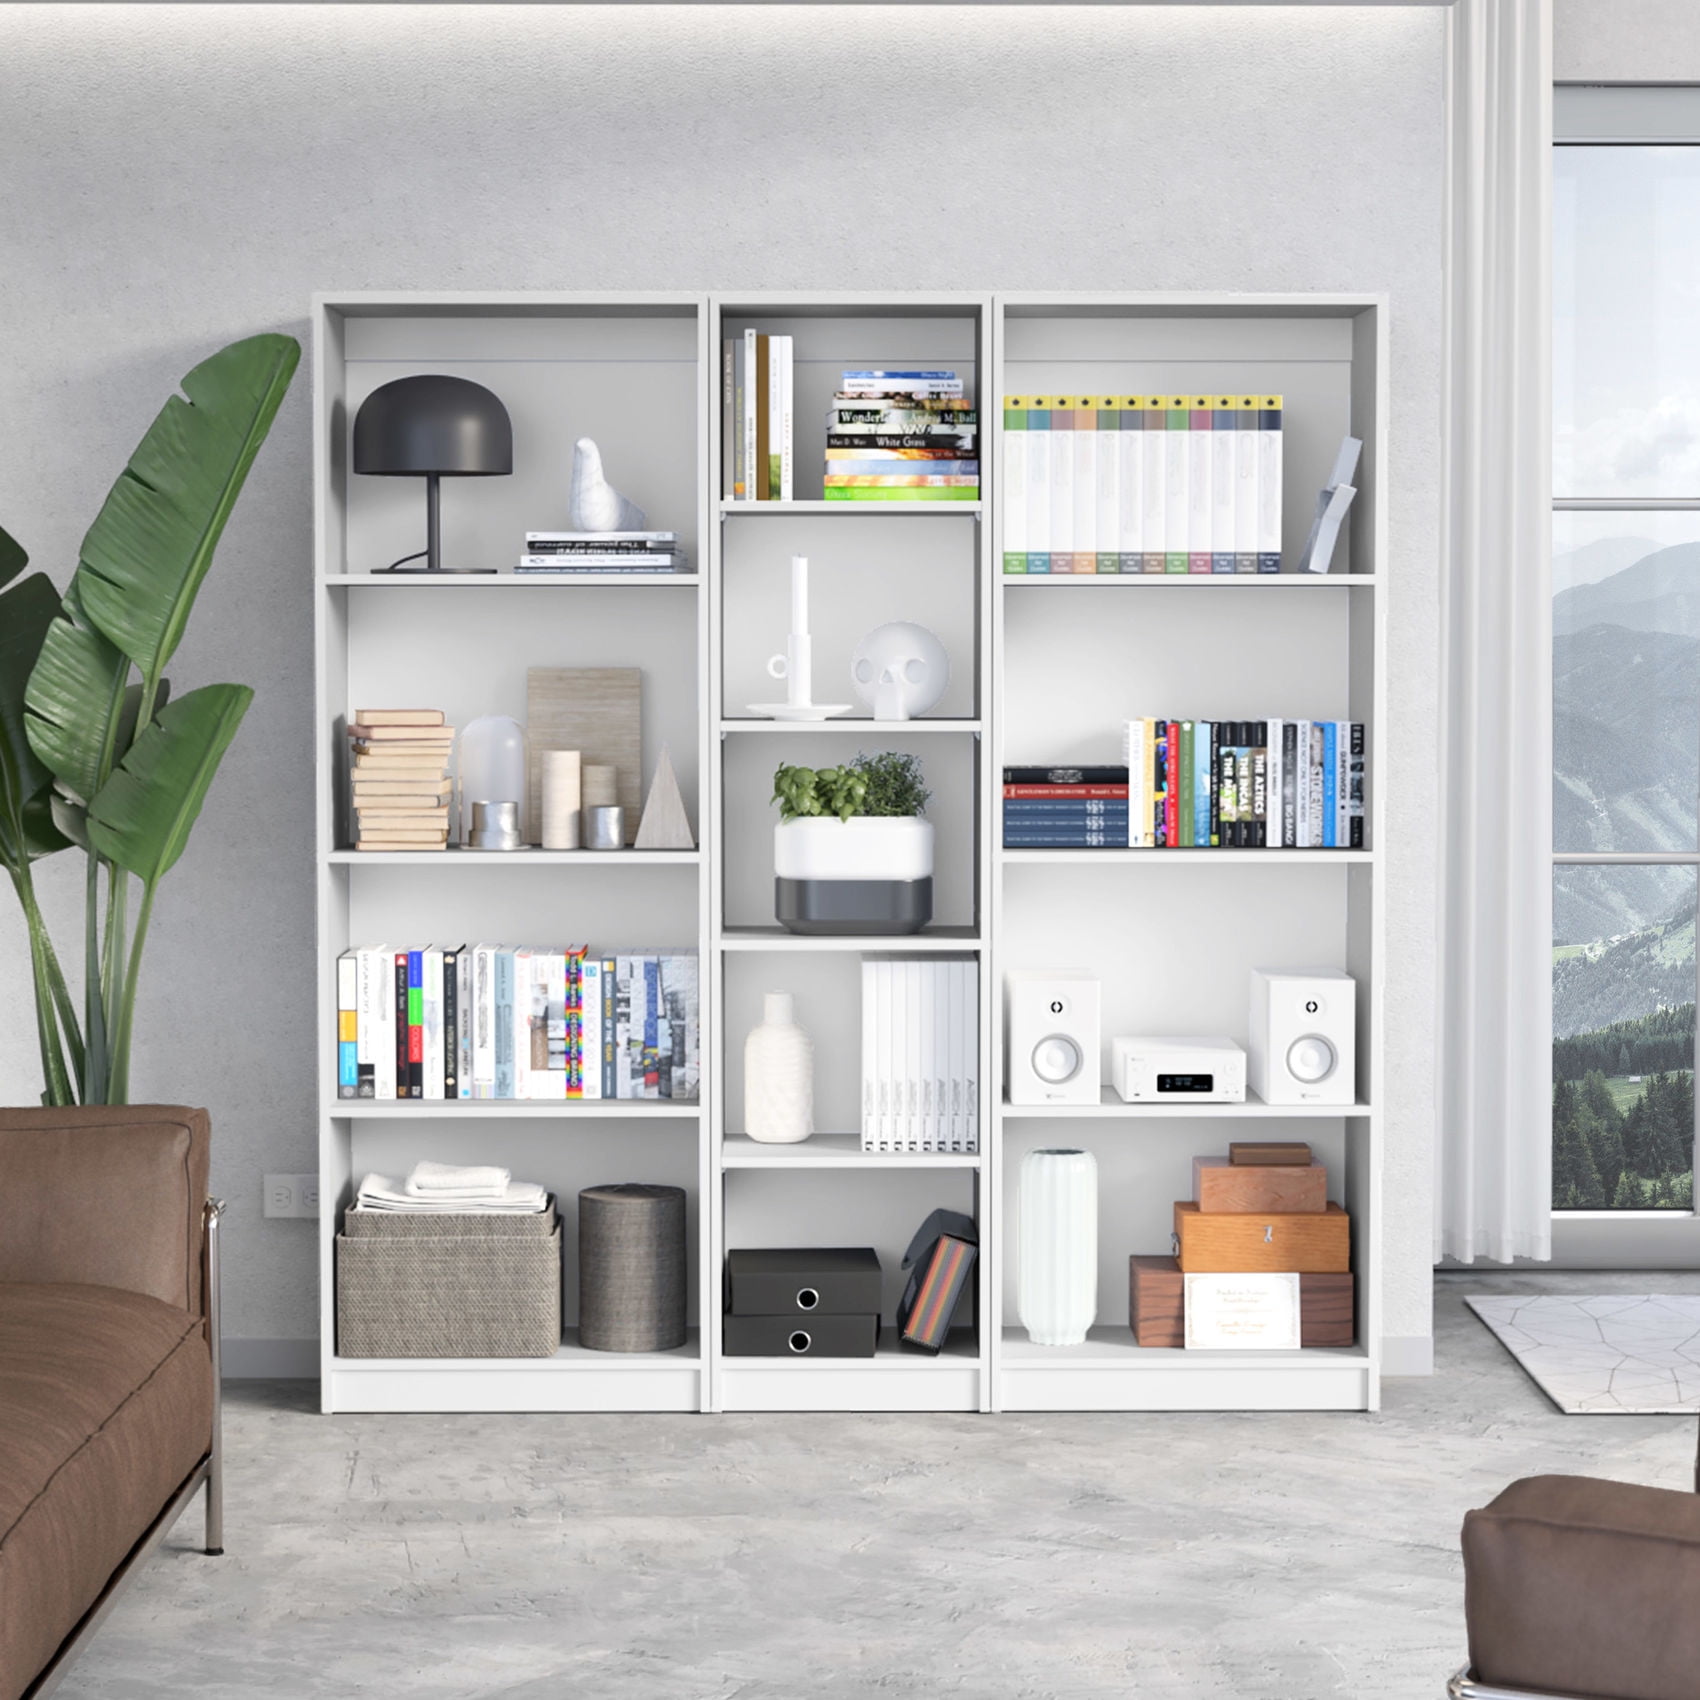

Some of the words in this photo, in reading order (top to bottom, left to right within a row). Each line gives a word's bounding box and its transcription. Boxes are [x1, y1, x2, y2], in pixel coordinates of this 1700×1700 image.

[876, 436, 900, 447] White
[903, 436, 926, 447] Grass
[1223, 756, 1233, 777] THE
[1239, 757, 1249, 777] THE
[1254, 754, 1264, 774] THE
[1300, 751, 1308, 764] NOT
[1300, 767, 1308, 786] ONLY
[1339, 751, 1347, 800] GUNPOWDER
[1223, 778, 1233, 812] MAYA
[1239, 779, 1249, 812] INCAS
[1254, 776, 1265, 815] AZTECS
[1300, 787, 1308, 800] FOR
[1310, 766, 1323, 845] STONEWORKS
[569, 955, 578, 973] Todd
[569, 983, 578, 1008] Banks
[604, 973, 613, 998] DESIGN
[569, 1013, 579, 1058] DESIGNING
[604, 1019, 613, 1029] OF
[411, 1026, 420, 1061] COLORS
[604, 1030, 613, 1043] THE
[569, 1060, 579, 1087] BRAND
